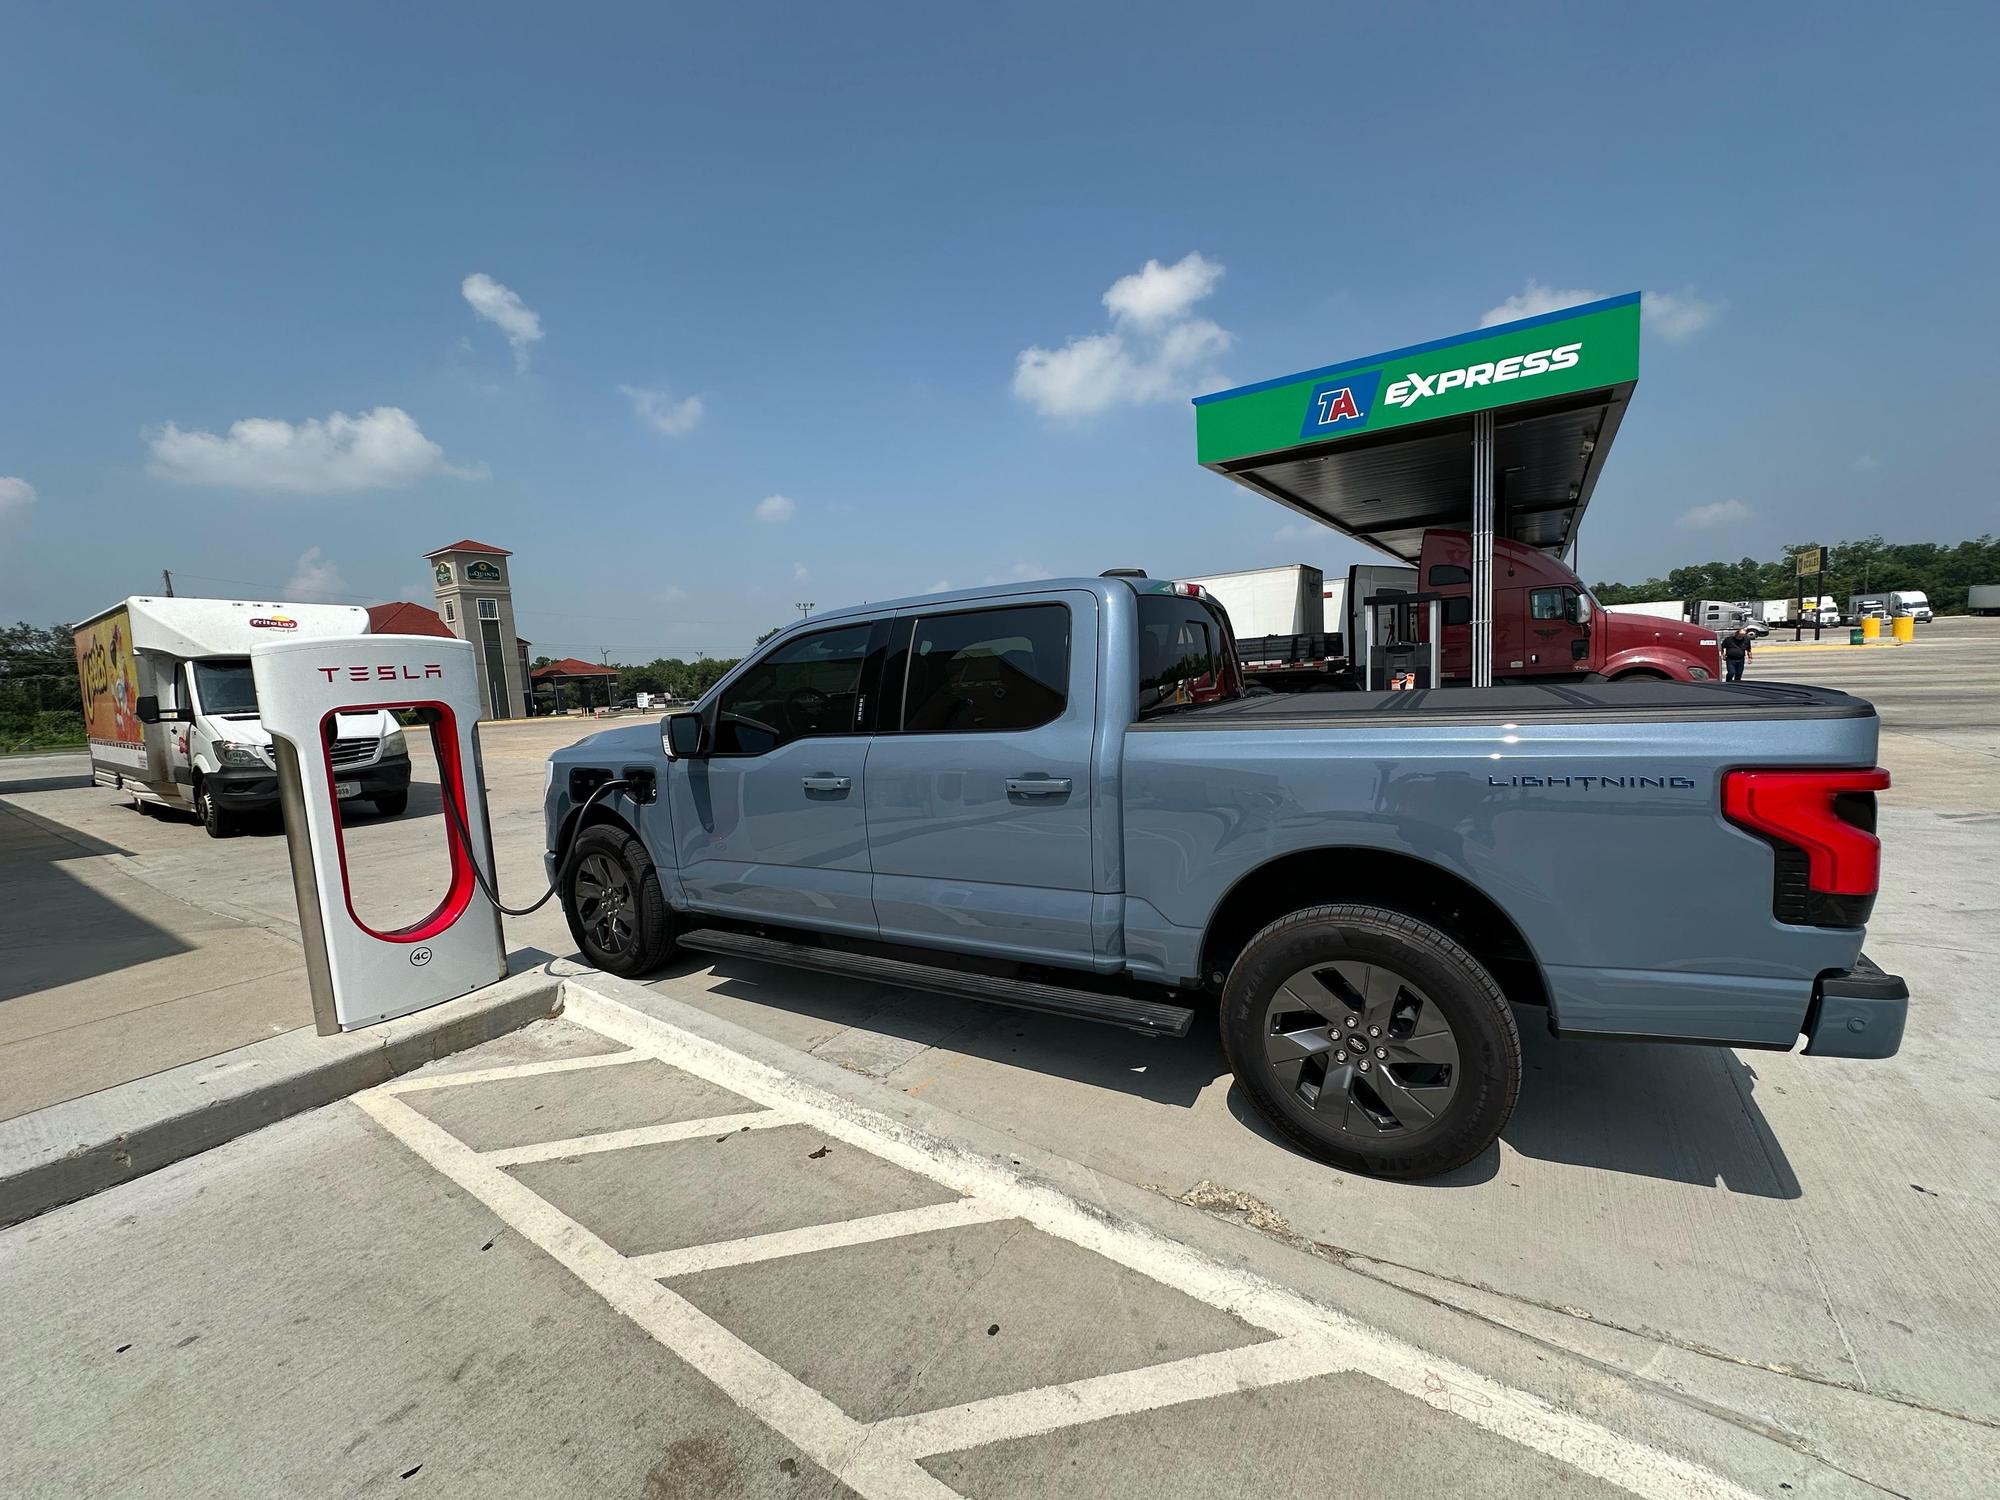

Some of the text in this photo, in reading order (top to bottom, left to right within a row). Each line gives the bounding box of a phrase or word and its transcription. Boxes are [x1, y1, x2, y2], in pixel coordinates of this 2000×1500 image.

[1318, 342, 1583, 425] TA EXPRESS
[317, 664, 442, 683] TESLA
[1488, 775, 1695, 791] LIGHTNING
[413, 951, 429, 961] 4C
